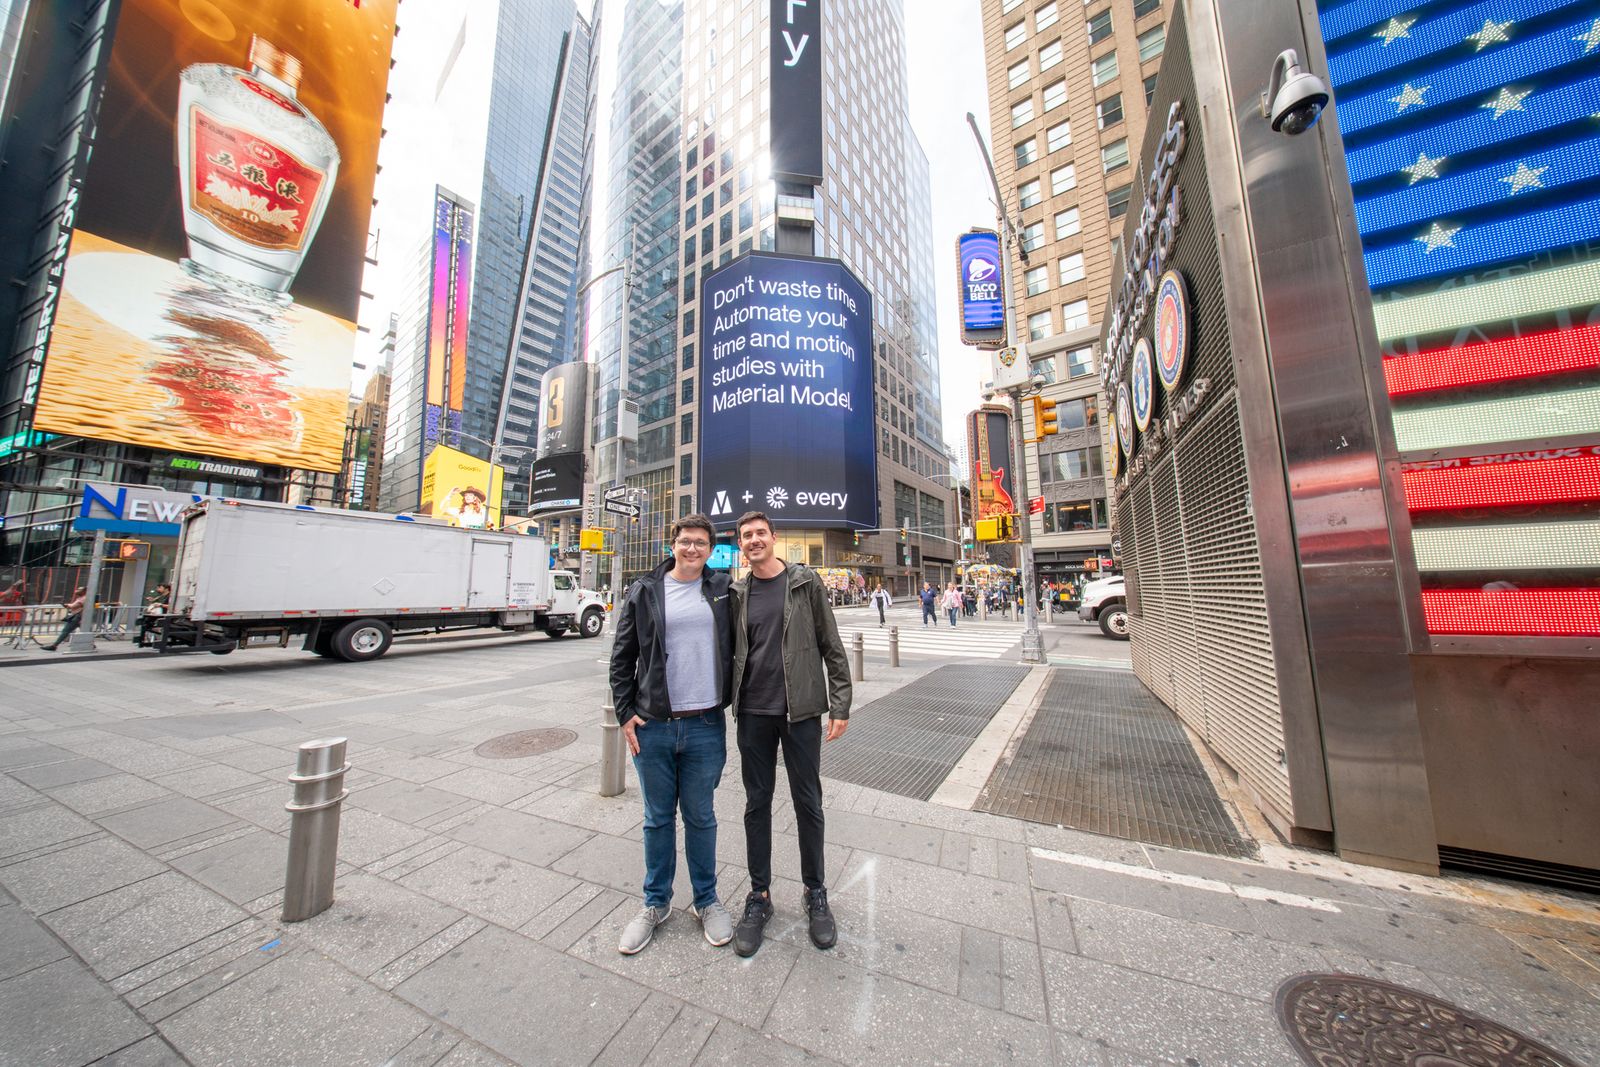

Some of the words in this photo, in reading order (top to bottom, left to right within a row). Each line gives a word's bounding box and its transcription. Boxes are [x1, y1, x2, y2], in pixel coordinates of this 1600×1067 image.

[714, 275, 754, 310] Don't
[759, 280, 821, 299] waste
[826, 283, 859, 316] time.
[967, 283, 997, 292] TACO
[970, 292, 998, 301] BELL
[713, 305, 802, 335] Automate
[807, 310, 847, 329] your
[713, 335, 746, 361] time
[750, 331, 790, 349] and
[796, 335, 855, 362] motion
[713, 356, 776, 386] studies
[781, 359, 824, 378] with
[547, 377, 565, 428] 3
[713, 384, 784, 413] Material
[791, 385, 853, 411] Model.
[547, 431, 562, 442] 24/7
[80, 483, 184, 523] NEW
[610, 503, 620, 511] ONE
[625, 507, 637, 515] WAY
[796, 492, 848, 510] every
